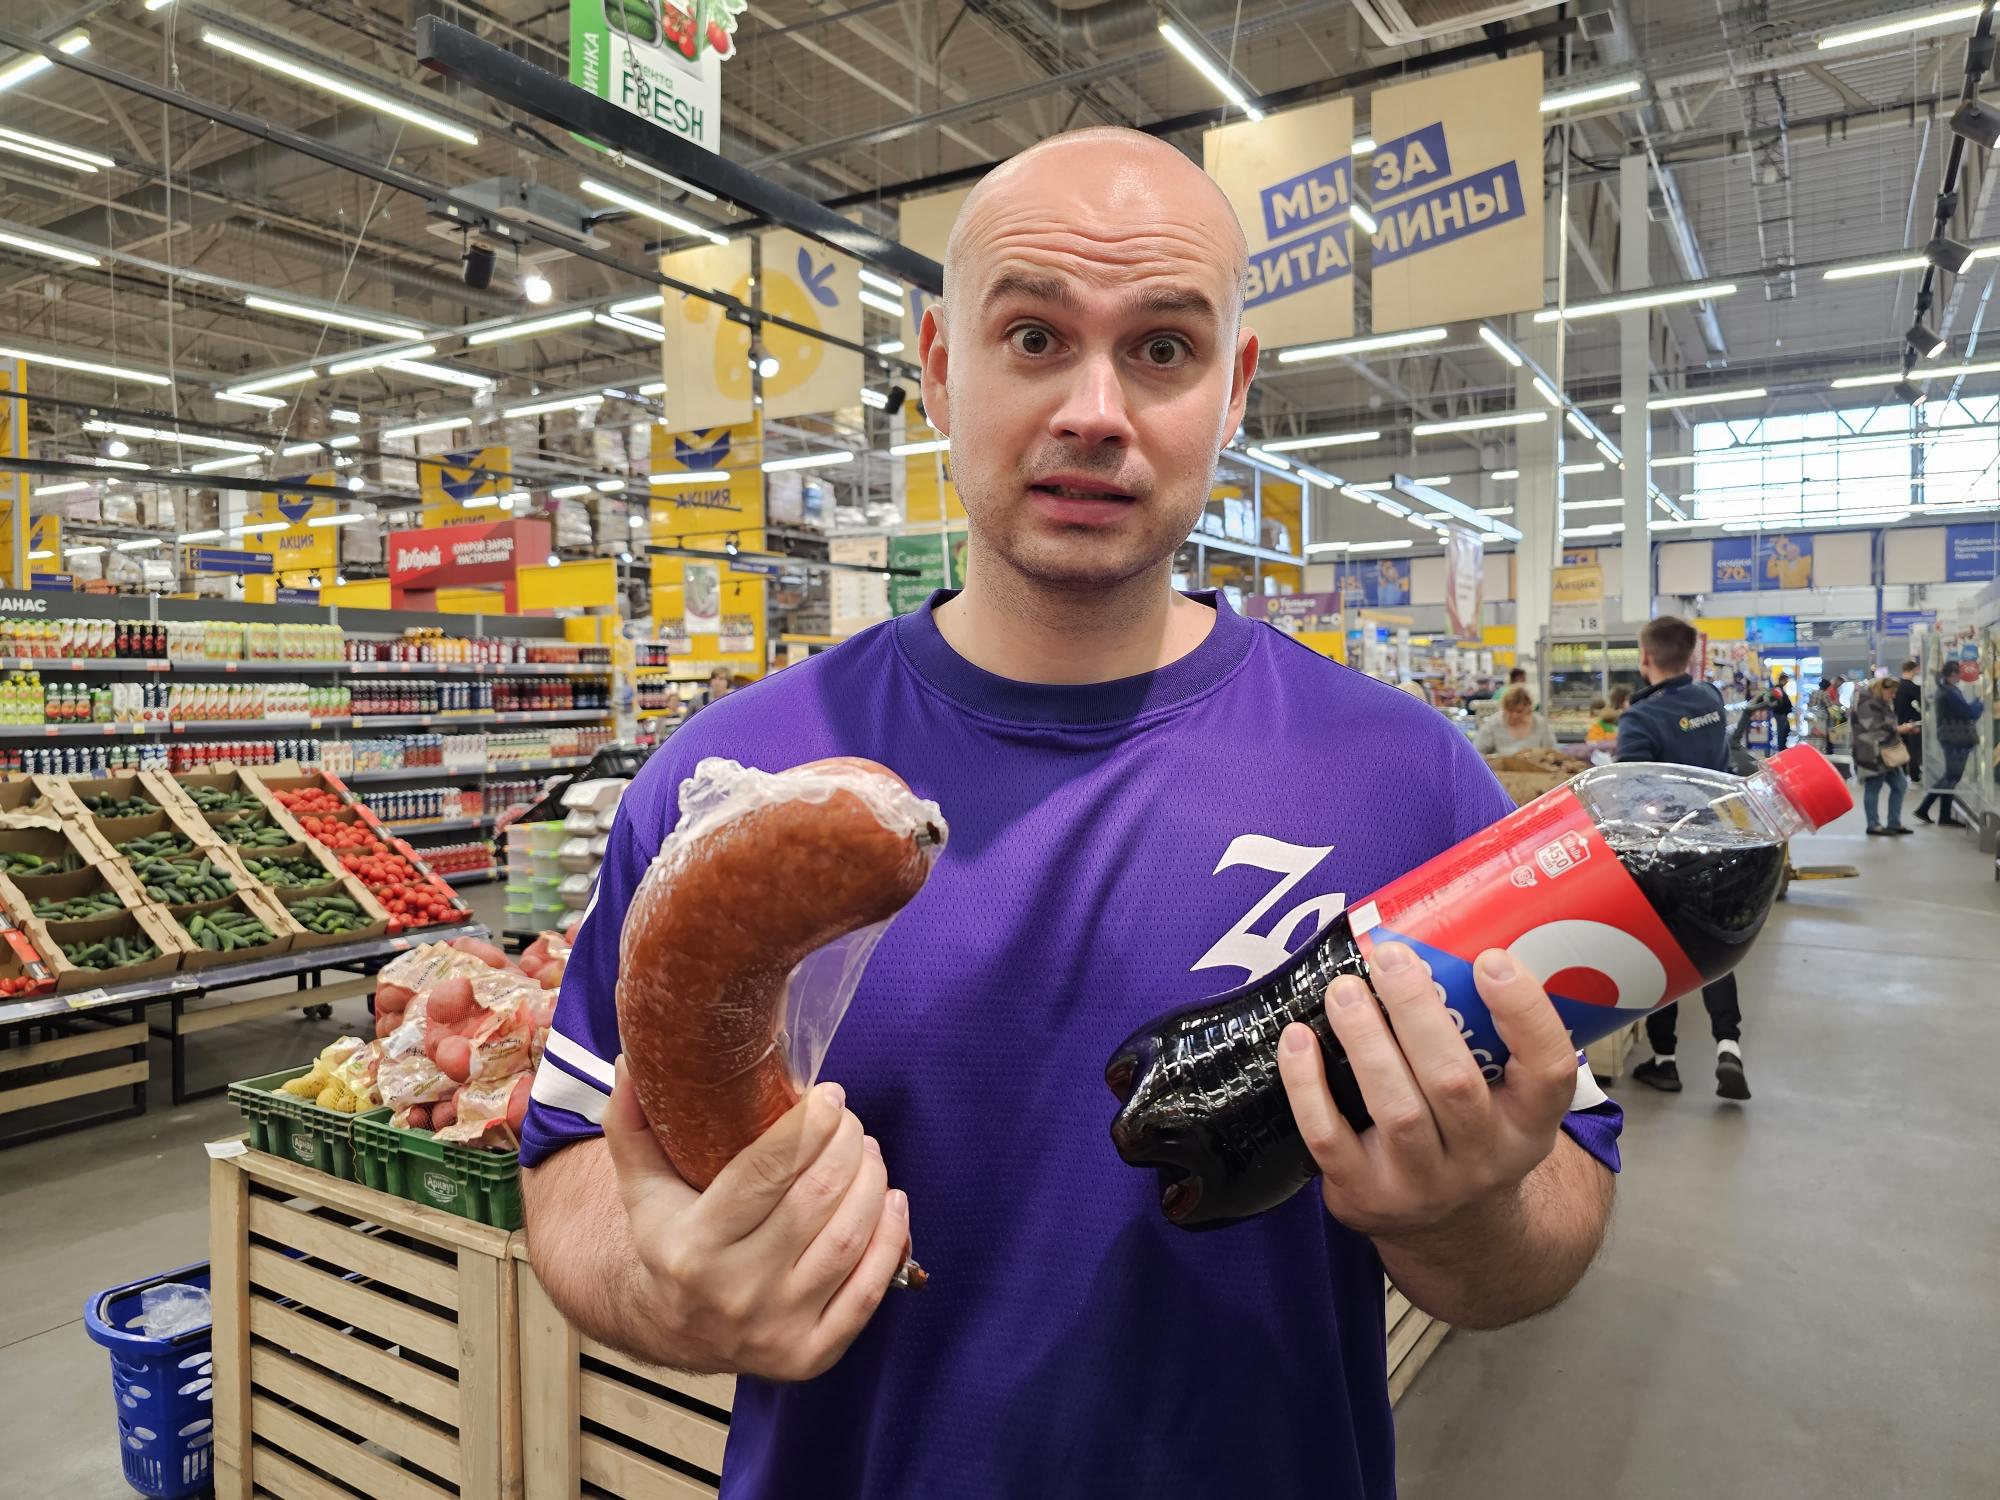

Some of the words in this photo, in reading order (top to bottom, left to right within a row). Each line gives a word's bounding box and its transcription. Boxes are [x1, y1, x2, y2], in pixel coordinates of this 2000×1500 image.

[623, 71, 704, 141] FRESH
[1271, 168, 1349, 229] МЫ
[1373, 140, 1438, 191] ЗА
[675, 488, 731, 509] АКЦИЯ
[279, 533, 314, 550] АКЦИЯ
[397, 545, 441, 572] Добрый
[1547, 845, 1569, 868] 45,0
